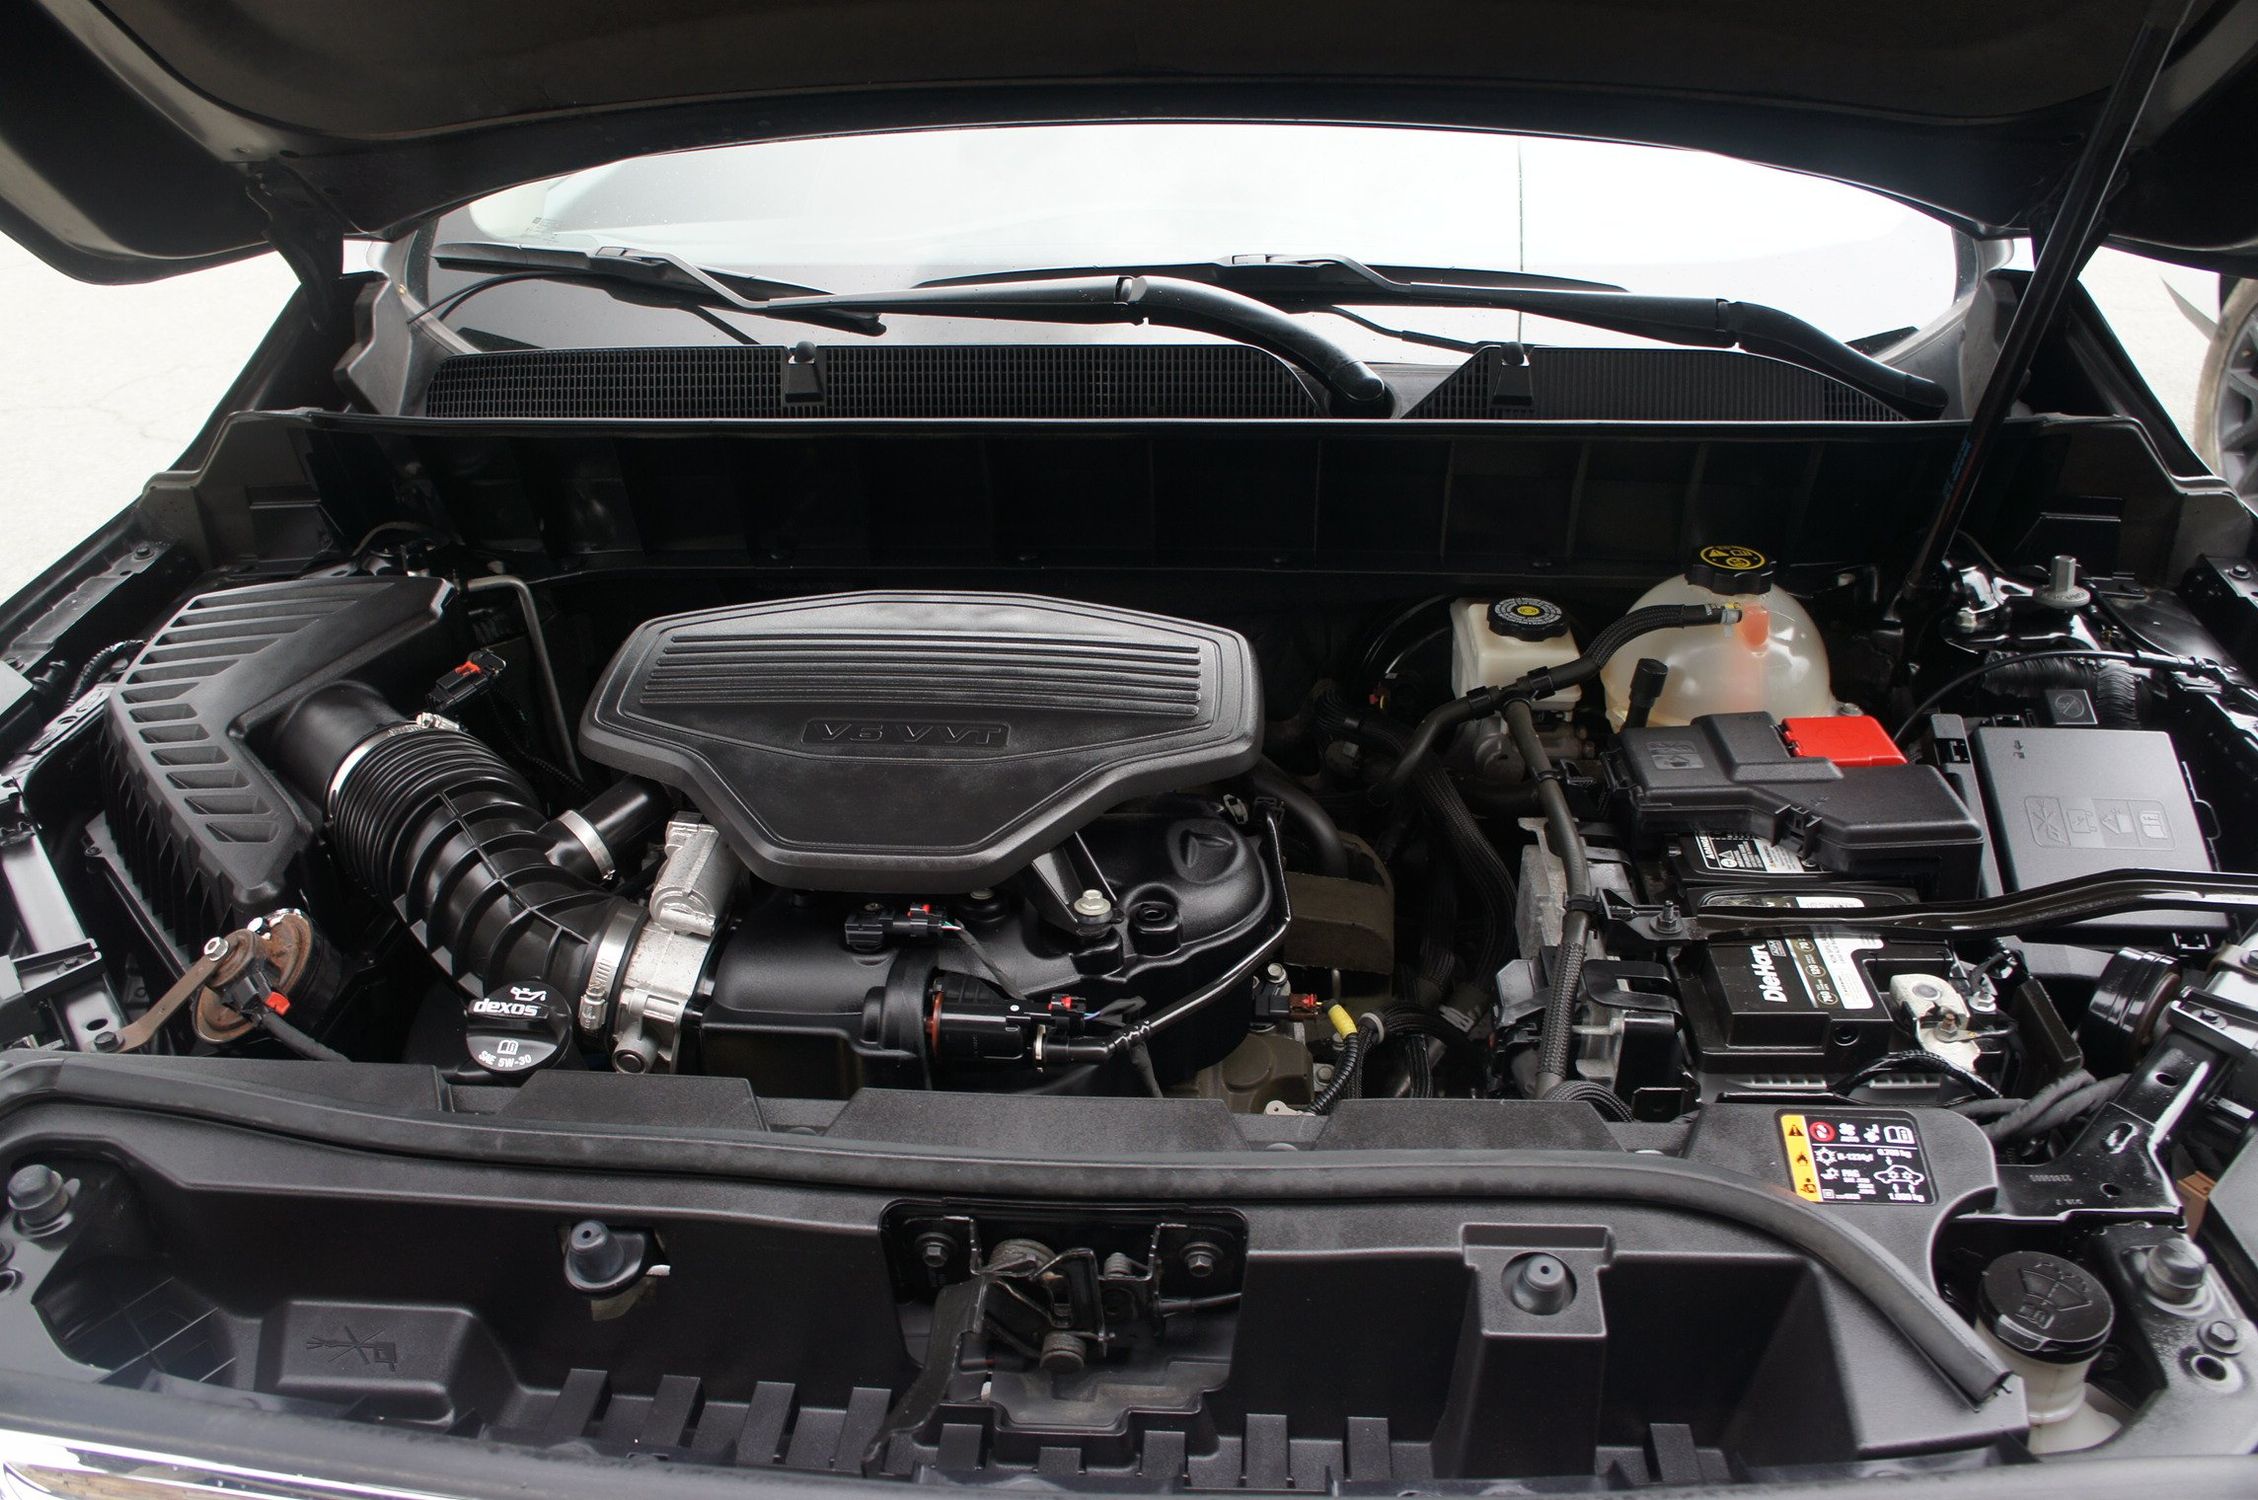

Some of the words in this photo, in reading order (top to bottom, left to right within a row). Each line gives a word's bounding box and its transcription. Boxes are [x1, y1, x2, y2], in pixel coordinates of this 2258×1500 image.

[814, 722, 884, 742] V6
[896, 724, 1002, 745] VVT
[473, 998, 539, 1016] dexos
[478, 1050, 497, 1065] SAE
[497, 1054, 532, 1068] 5W-30
